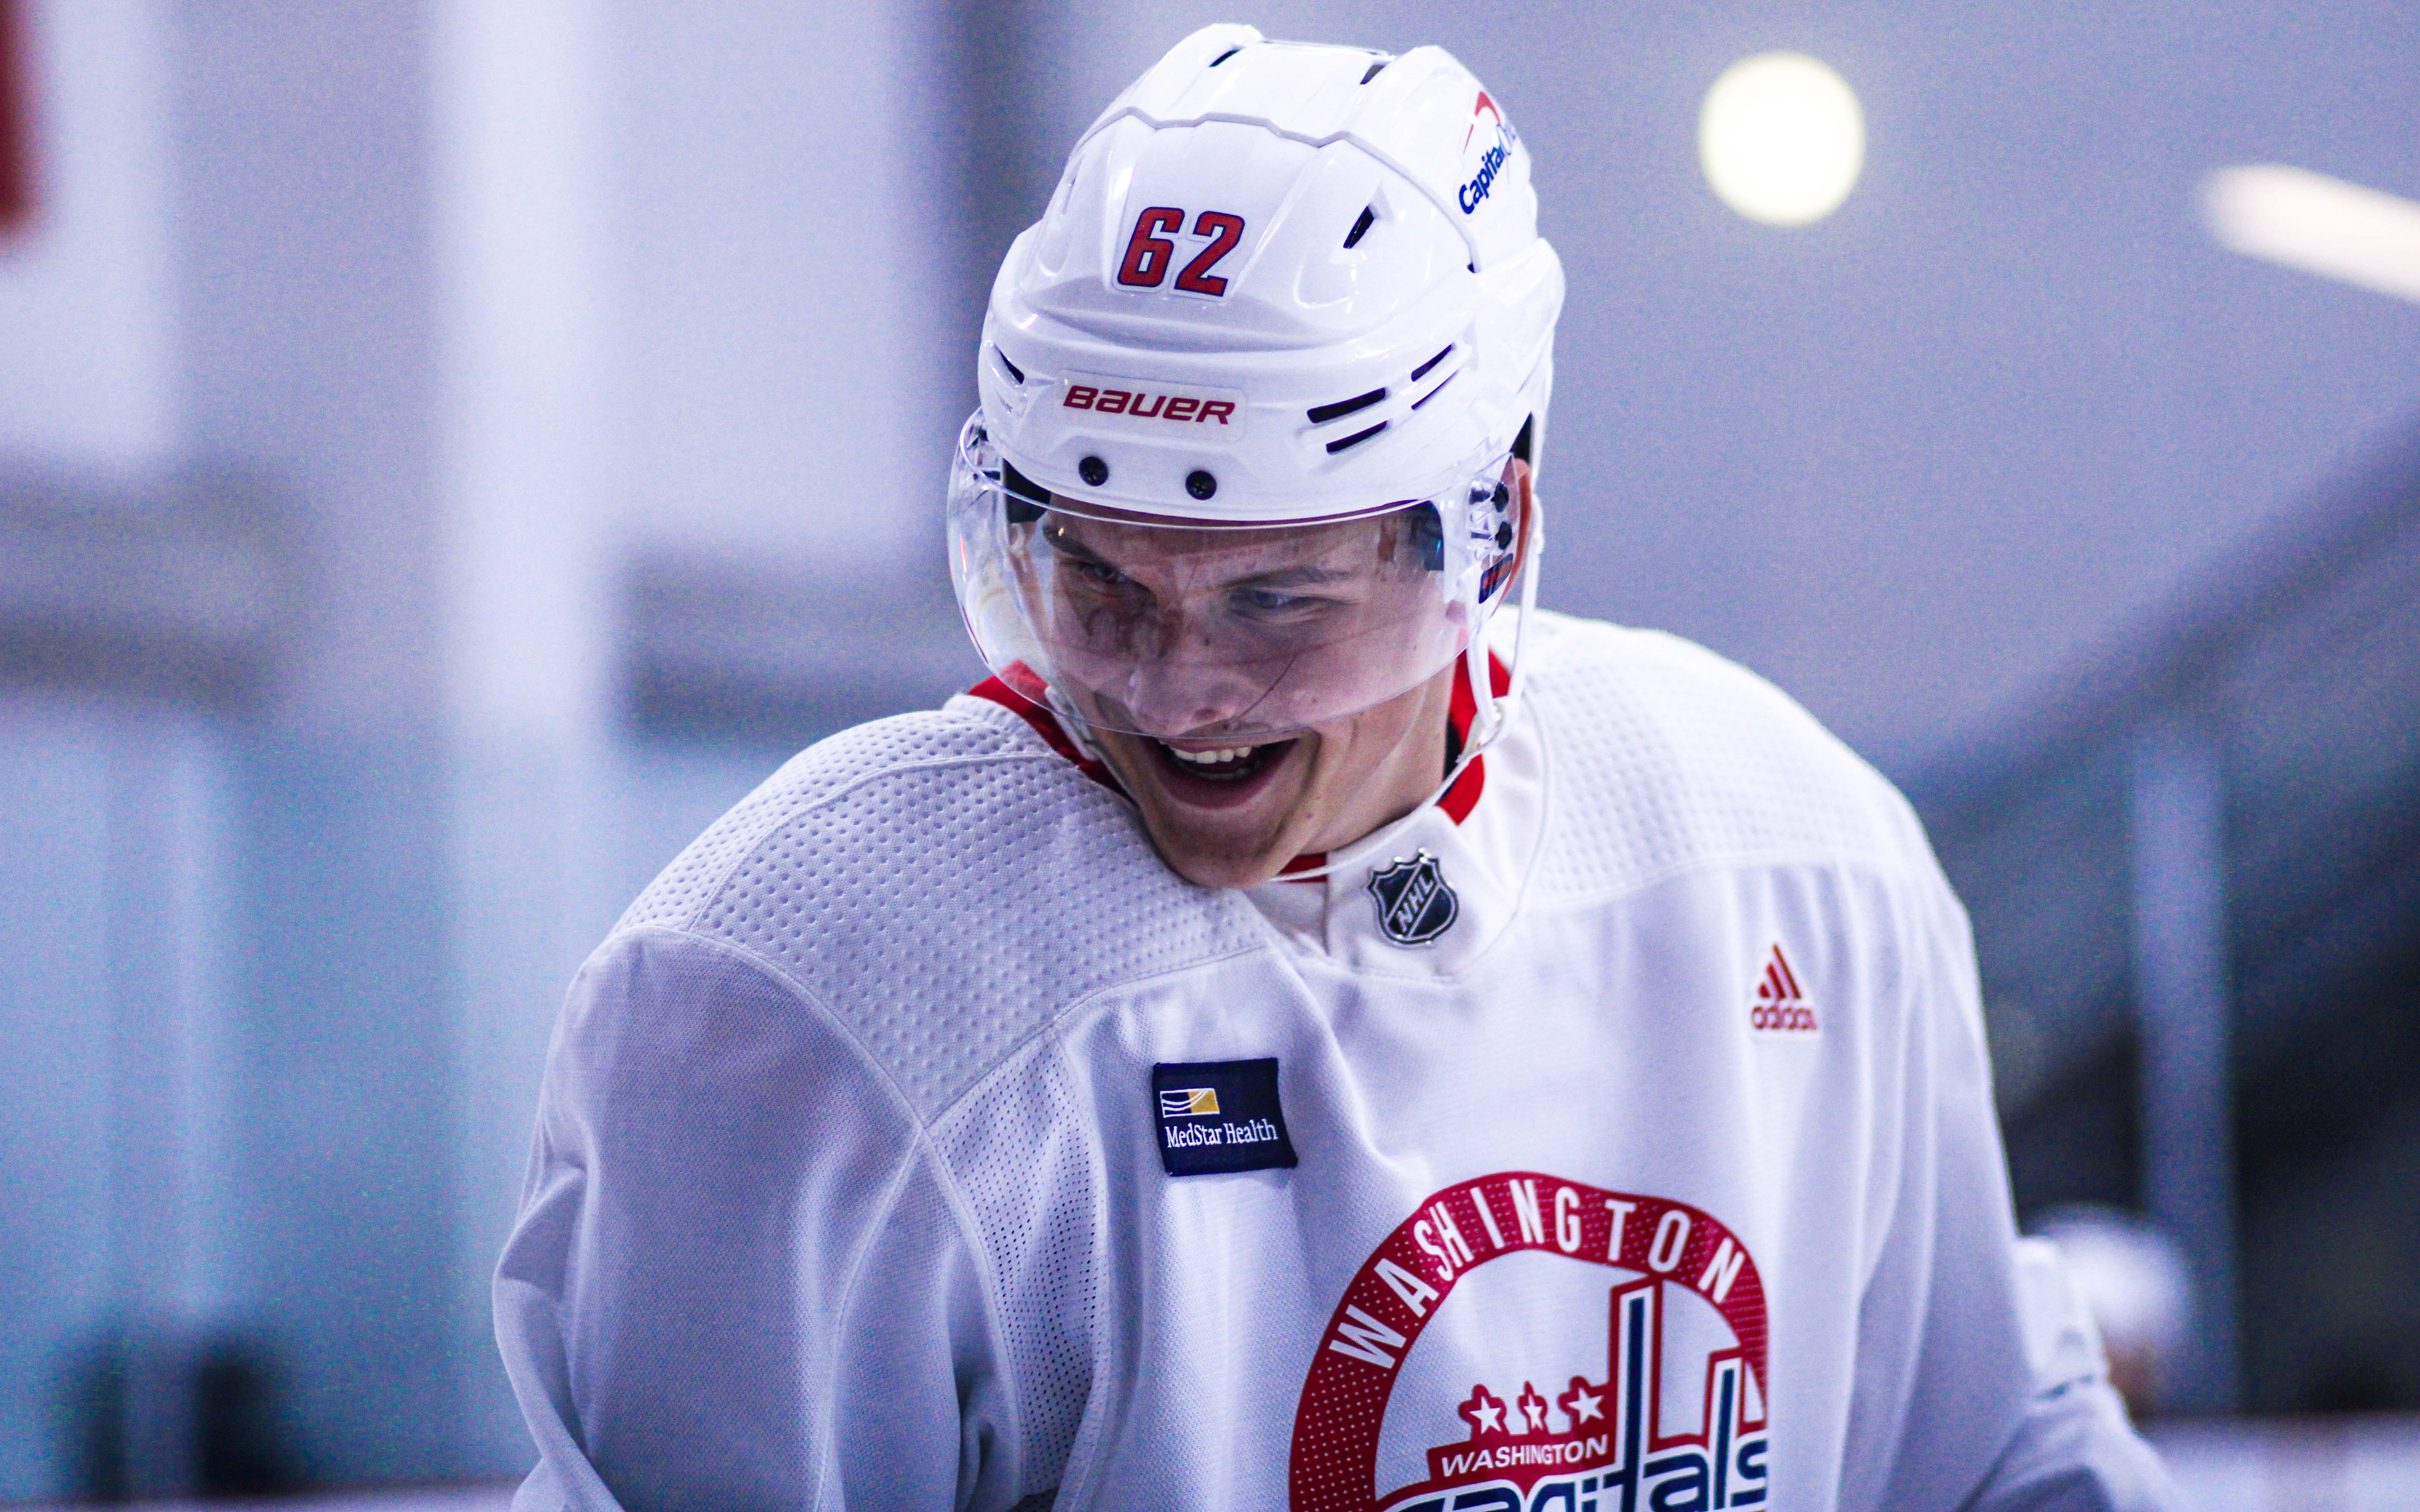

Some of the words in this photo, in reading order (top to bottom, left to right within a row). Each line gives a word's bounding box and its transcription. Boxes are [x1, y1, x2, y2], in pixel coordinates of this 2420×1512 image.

[1117, 207, 1245, 297] 62
[1396, 874, 1434, 933] NHL
[1165, 1123, 1222, 1148] MedStar
[1223, 1119, 1278, 1144] Health
[1329, 1179, 1745, 1369] WASHINGTON
[1441, 1434, 1608, 1477] WASHINGTON
